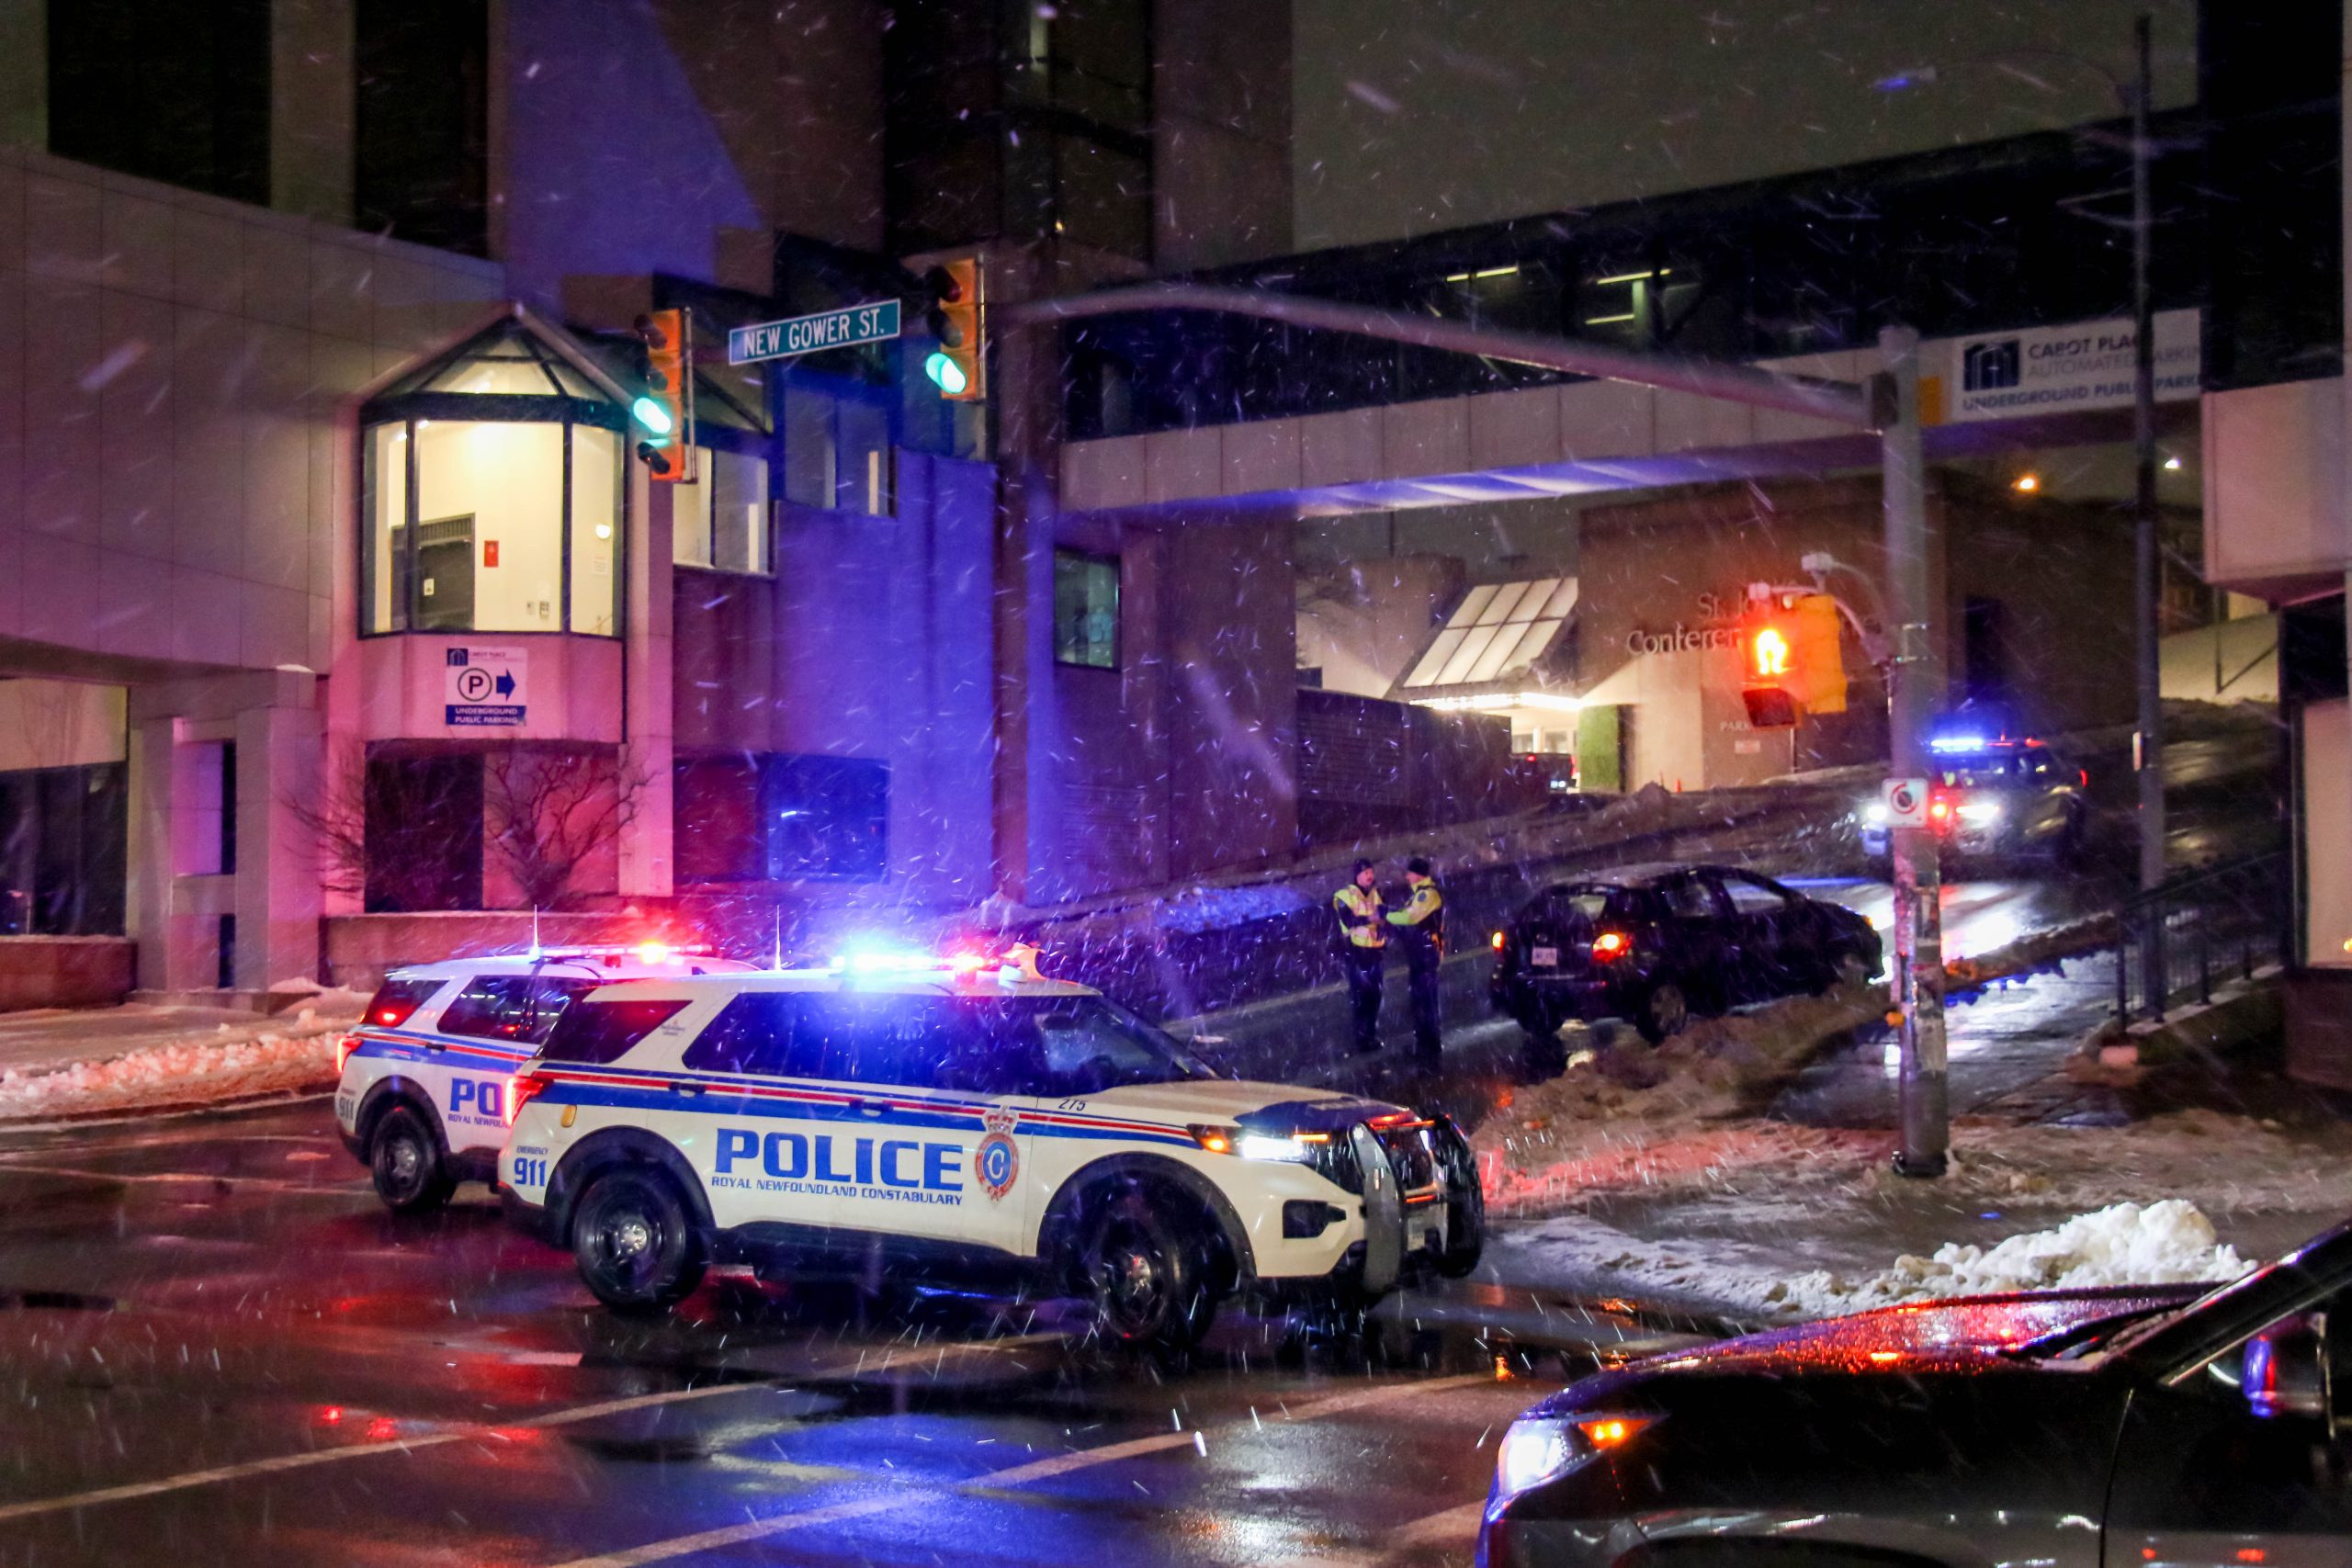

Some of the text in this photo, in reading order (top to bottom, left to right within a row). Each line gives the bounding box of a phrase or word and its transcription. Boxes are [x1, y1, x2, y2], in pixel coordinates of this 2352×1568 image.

[744, 308, 885, 357] NEW GOWER ST.
[2029, 338, 2091, 360] CABOT
[1963, 385, 2089, 411] UNDERGROUND
[2095, 380, 2136, 398] PUBL
[469, 675, 484, 694] P
[455, 706, 518, 716] UNDERGROUND
[339, 1096, 355, 1121] 911
[1058, 1097, 1087, 1111] 275
[448, 1113, 472, 1124] ROYAL
[514, 1156, 548, 1187] 911
[715, 1128, 964, 1191] POLICE
[711, 1176, 964, 1206] ROYAL NEWFOUNDLAND CONSTABULARY
